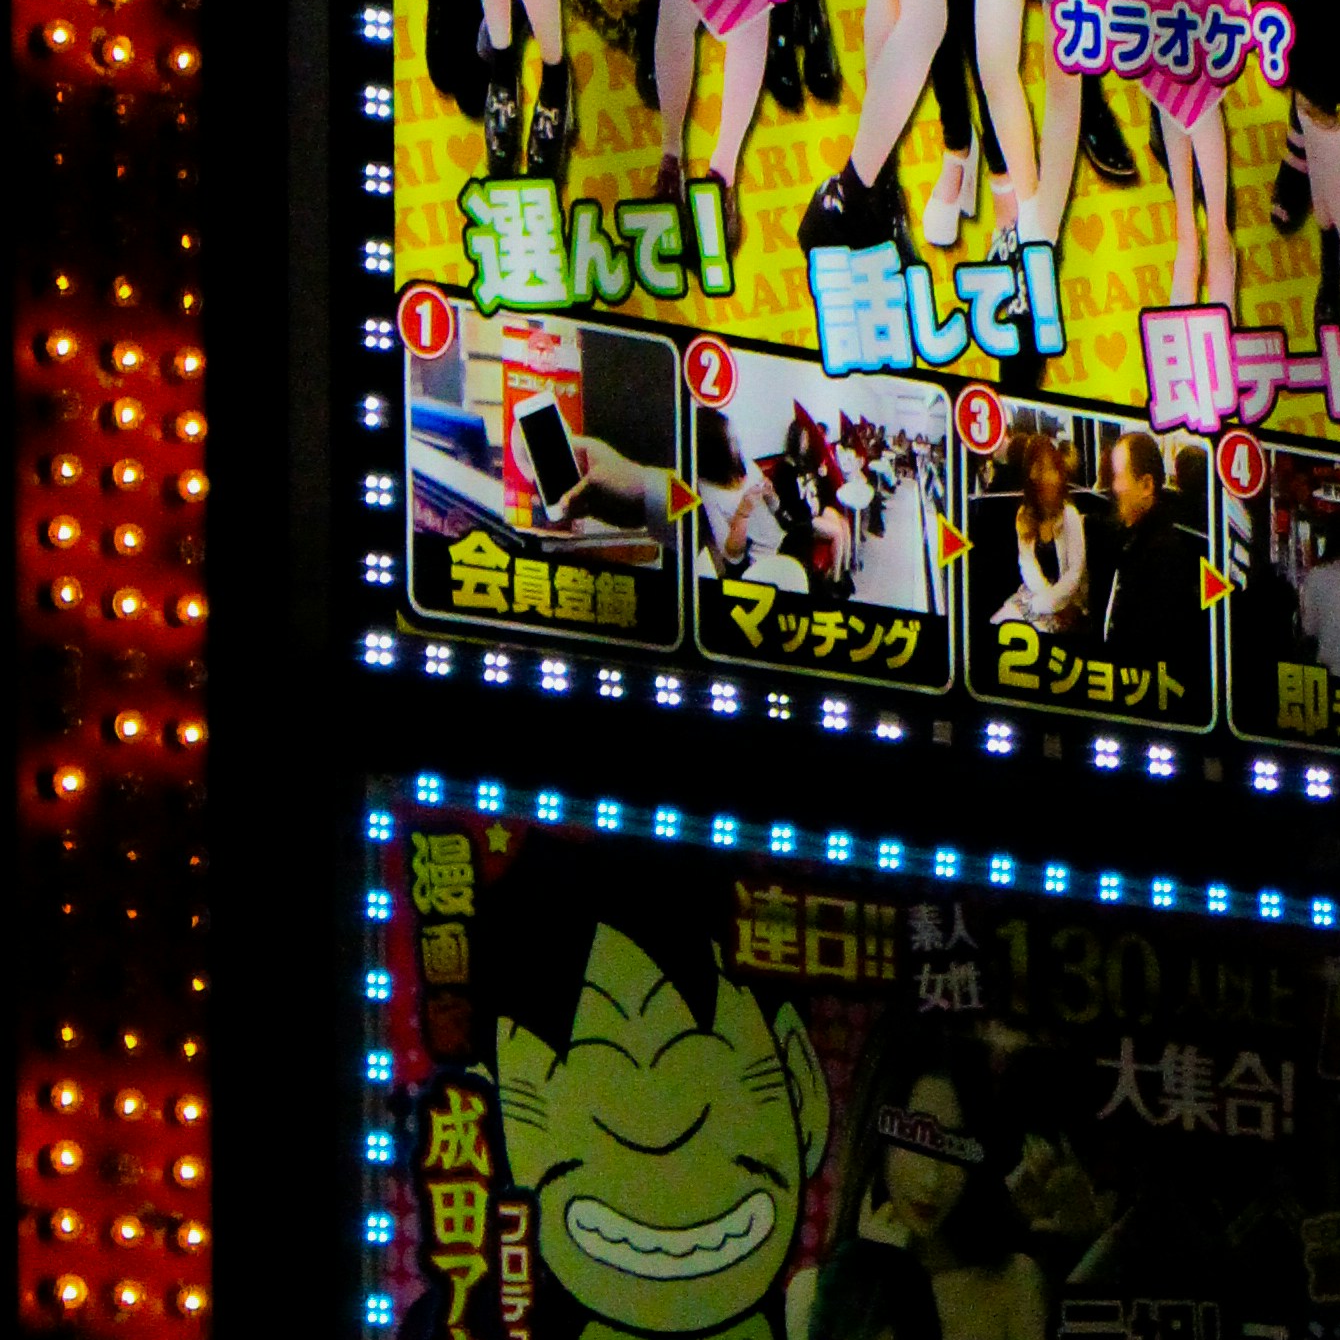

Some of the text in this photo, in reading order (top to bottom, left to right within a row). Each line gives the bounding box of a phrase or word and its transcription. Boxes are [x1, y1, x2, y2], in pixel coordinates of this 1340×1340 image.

[464, 178, 732, 312] 選んで！
[806, 241, 1064, 377] 話して！
[448, 531, 638, 629] 会員登録
[721, 577, 922, 670] マッチング
[997, 619, 1186, 711] 2ショット
[1095, 1034, 1298, 1146] 大集合！
